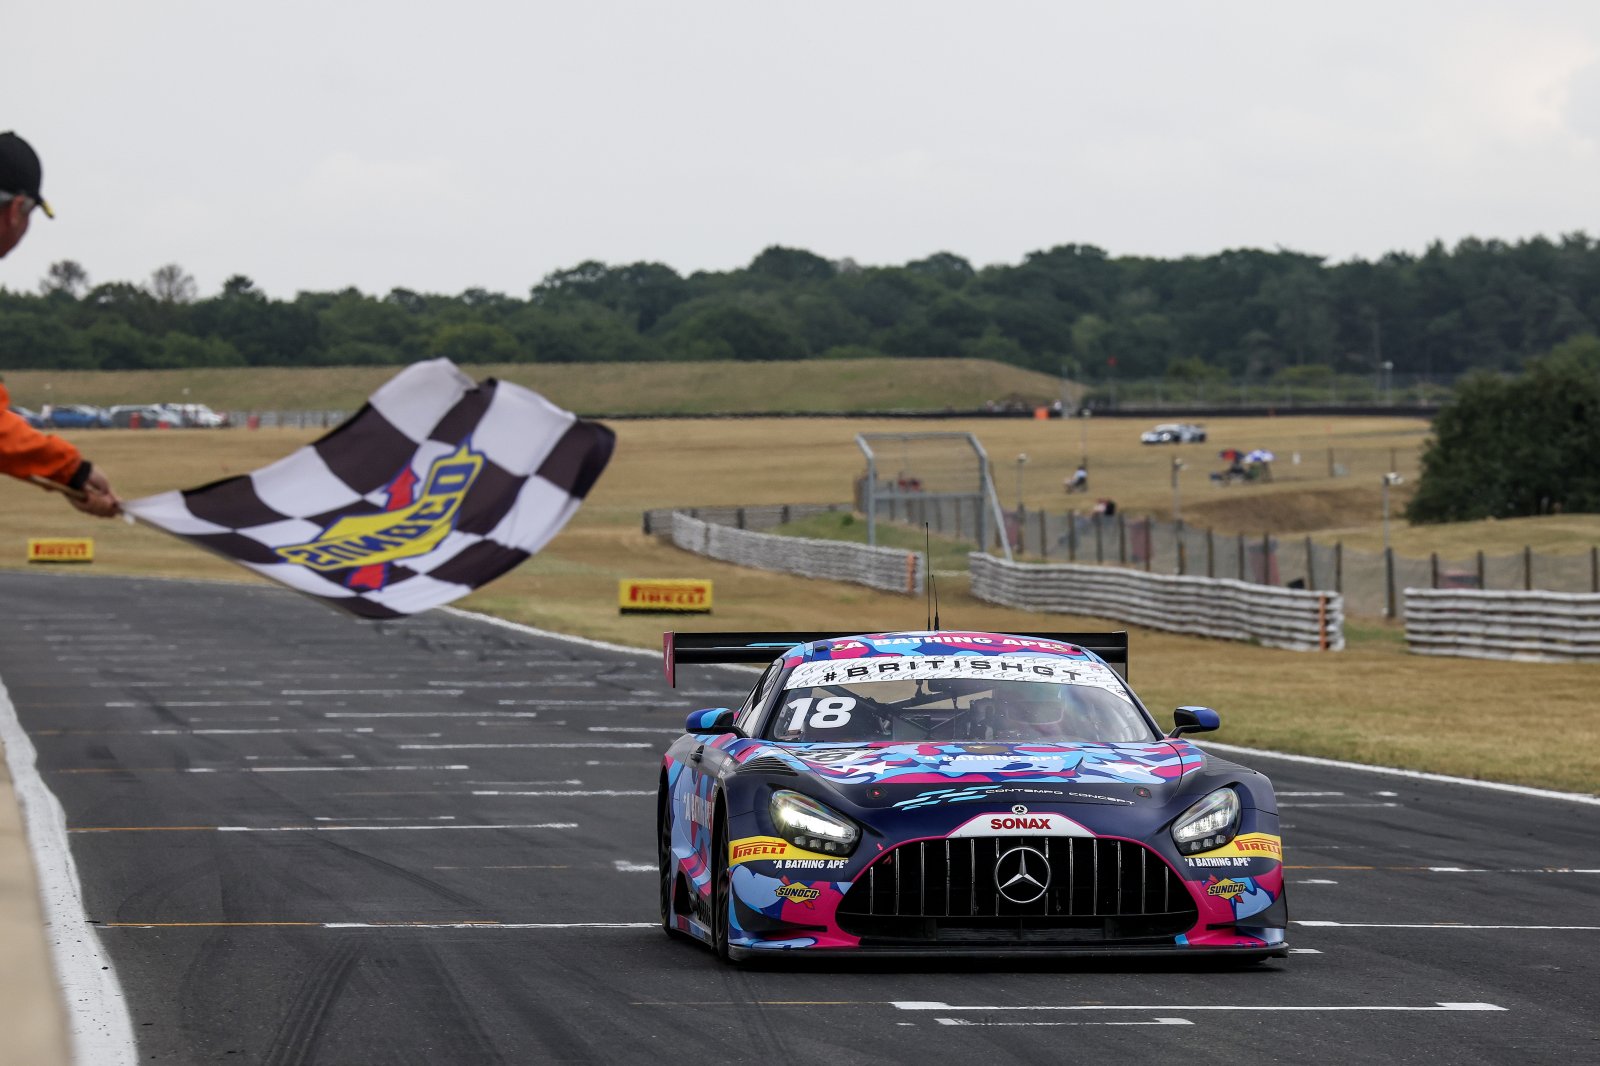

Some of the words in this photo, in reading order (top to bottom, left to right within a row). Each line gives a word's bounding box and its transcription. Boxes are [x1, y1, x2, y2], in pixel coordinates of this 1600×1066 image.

[873, 636, 993, 646] BATHING
[823, 660, 1082, 682] #BRITISHGT
[787, 696, 857, 731] 18
[990, 817, 1052, 830] SONAX
[732, 841, 788, 859] PIRELLI
[1234, 838, 1281, 855] PIRELLI
[785, 860, 826, 869] BATHING
[1196, 858, 1232, 867] BATHING
[778, 887, 819, 899] SUNOCO
[1209, 884, 1244, 895] SUNOCO
